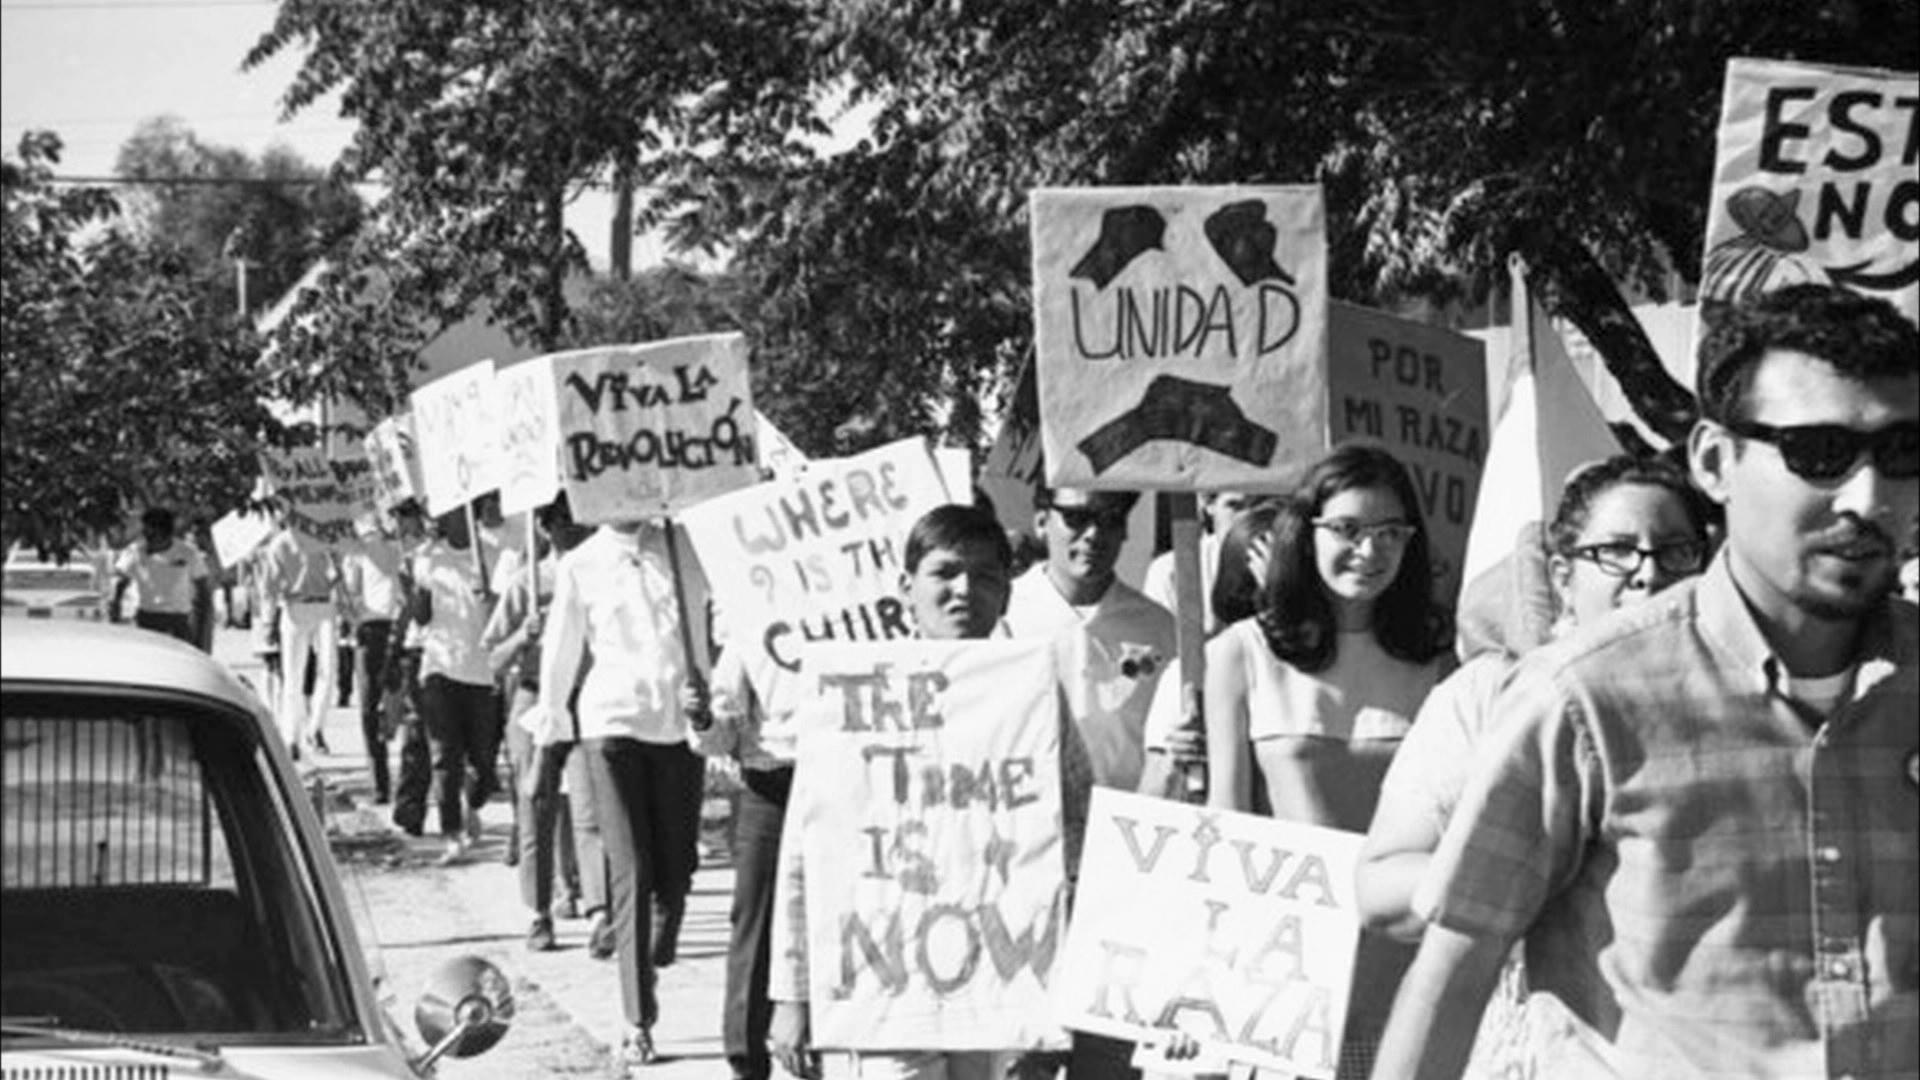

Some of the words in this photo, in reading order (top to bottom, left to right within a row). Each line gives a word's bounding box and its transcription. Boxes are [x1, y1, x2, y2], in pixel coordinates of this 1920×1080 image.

[1069, 284, 1300, 360] UNIDAD
[1367, 338, 1447, 397] POR
[1344, 395, 1383, 438] MI
[1396, 404, 1481, 468] RAZA
[733, 461, 909, 554] WHERE
[793, 555, 833, 593] IS
[840, 536, 899, 579] TH
[861, 819, 939, 896] IS
[831, 880, 1066, 1001] NOW
[1203, 899, 1309, 982] LA
[1086, 939, 1337, 1071] RAZA
